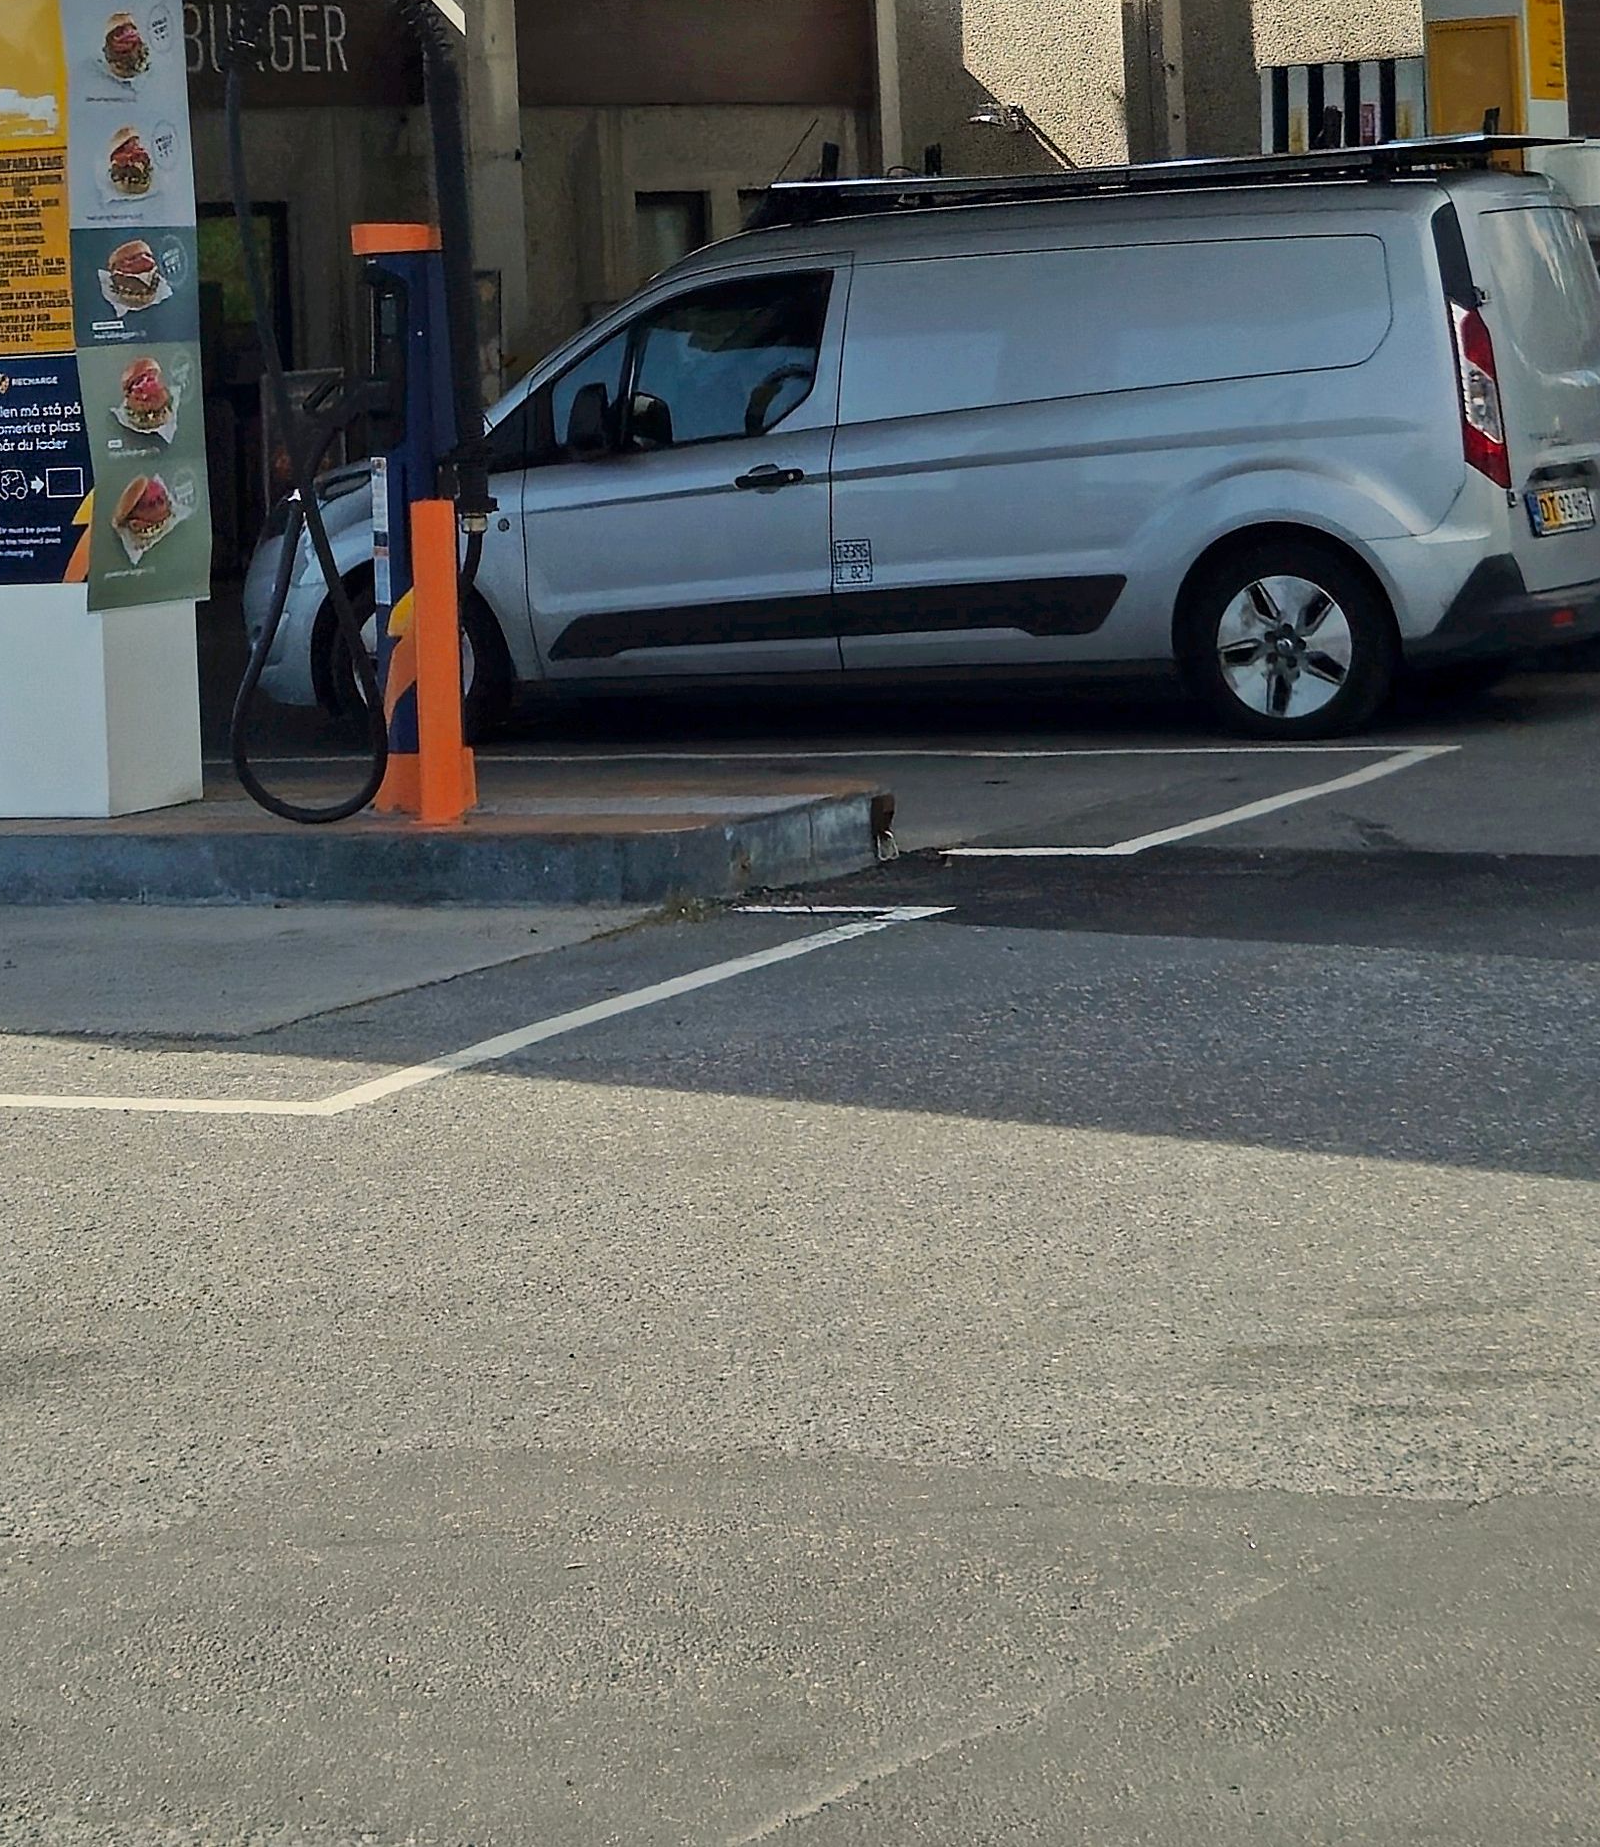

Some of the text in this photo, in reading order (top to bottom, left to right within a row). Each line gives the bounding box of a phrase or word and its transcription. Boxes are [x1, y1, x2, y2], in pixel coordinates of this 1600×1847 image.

[183, 3, 348, 73] BUGER
[11, 376, 58, 386] RECHARGE
[20, 403, 40, 417] må
[42, 402, 62, 416] stå
[64, 402, 81, 420] på
[49, 420, 81, 437] plass
[17, 439, 33, 451] du
